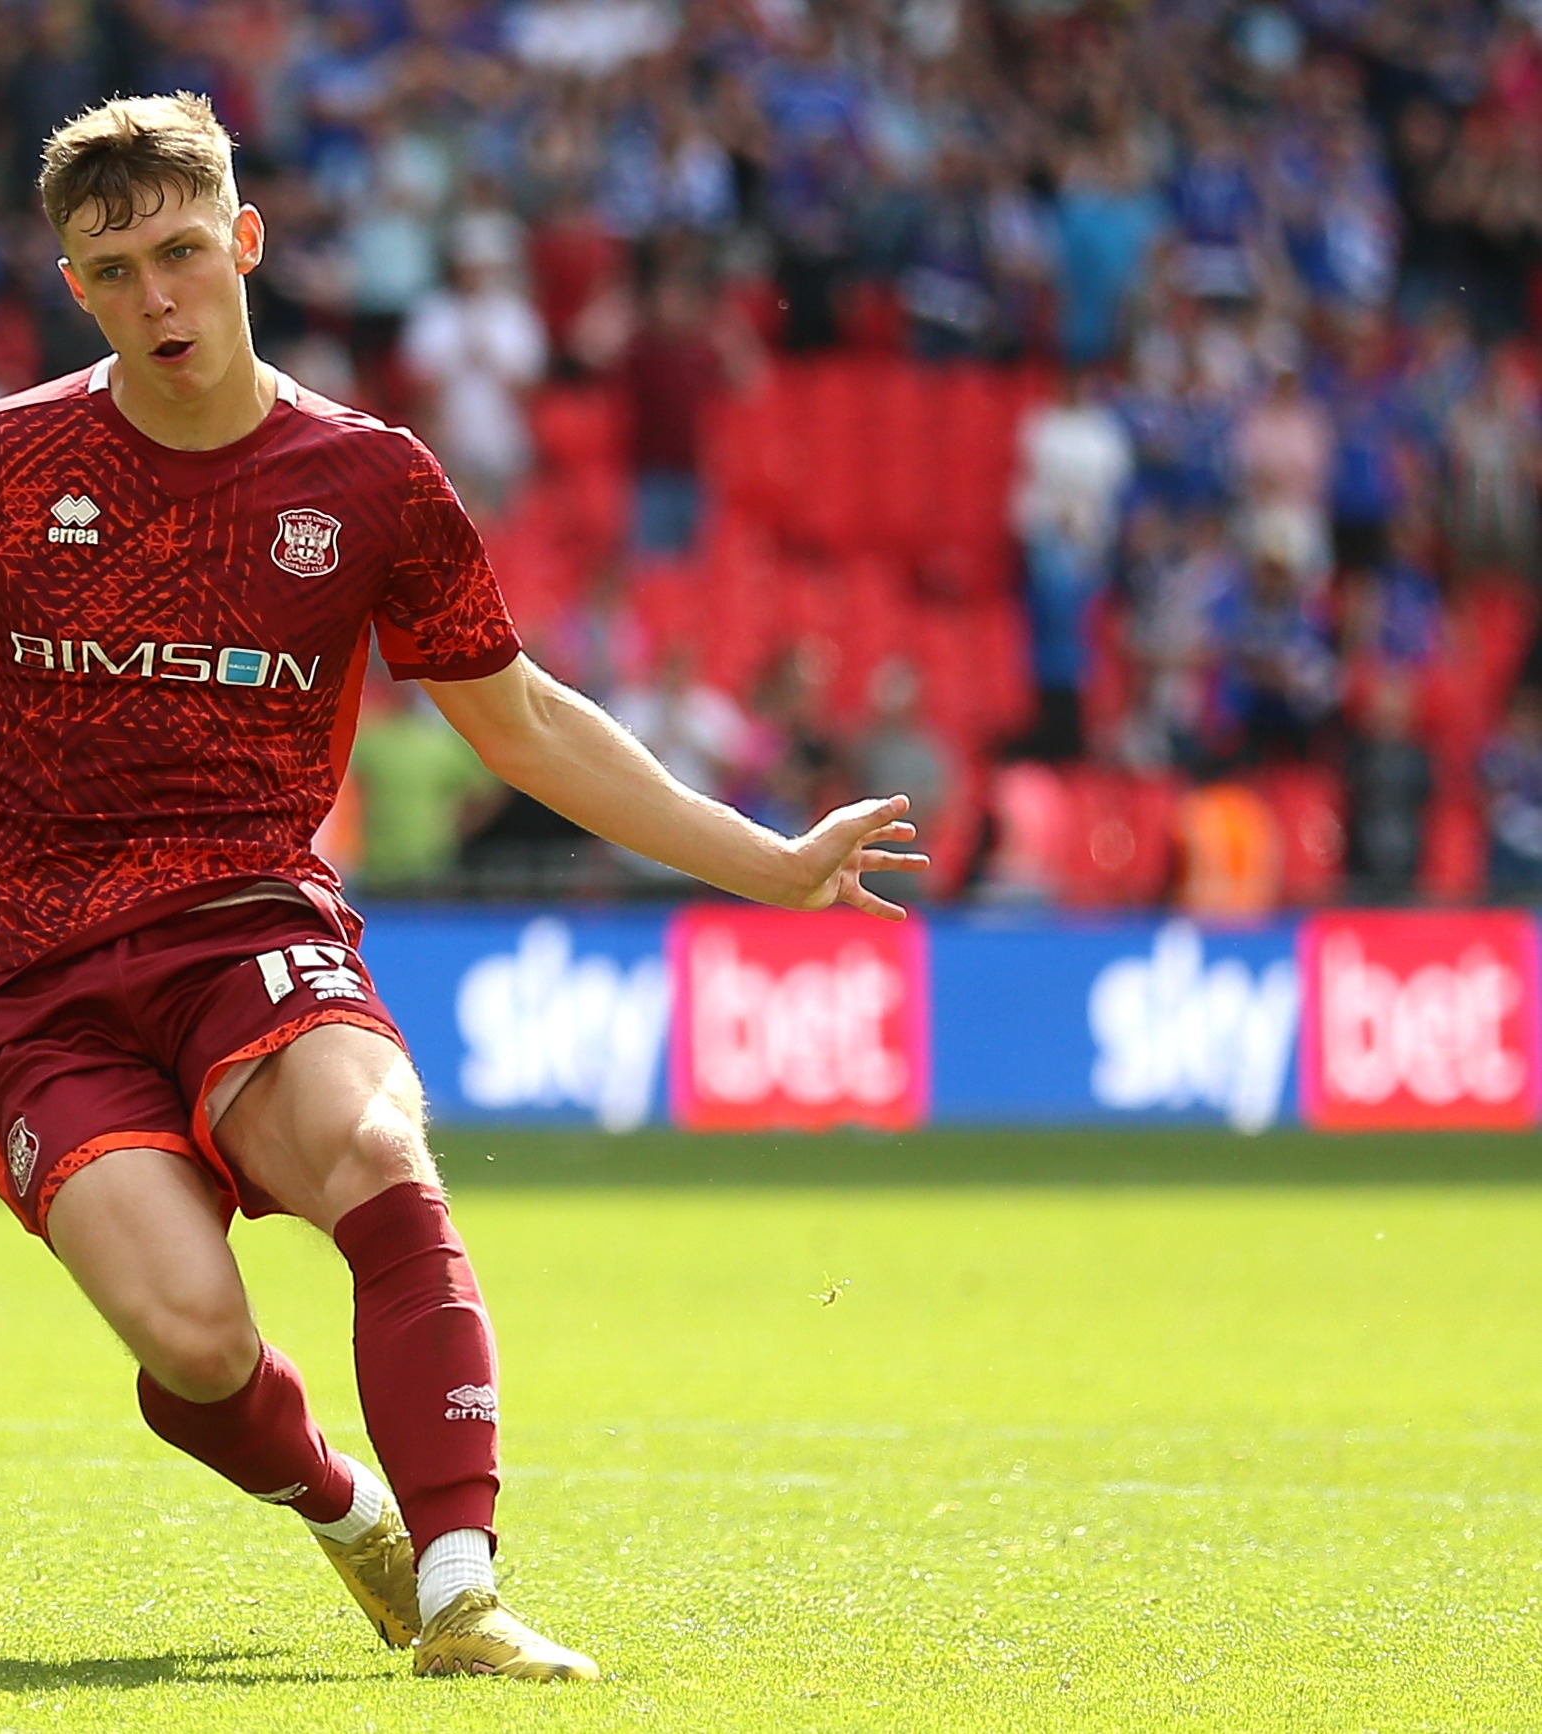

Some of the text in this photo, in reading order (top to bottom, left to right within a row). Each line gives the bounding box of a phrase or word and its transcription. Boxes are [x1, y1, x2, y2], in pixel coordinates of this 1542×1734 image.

[48, 527, 99, 545] errea
[456, 917, 910, 1134] sky bet
[1087, 916, 1527, 1136] sky bet
